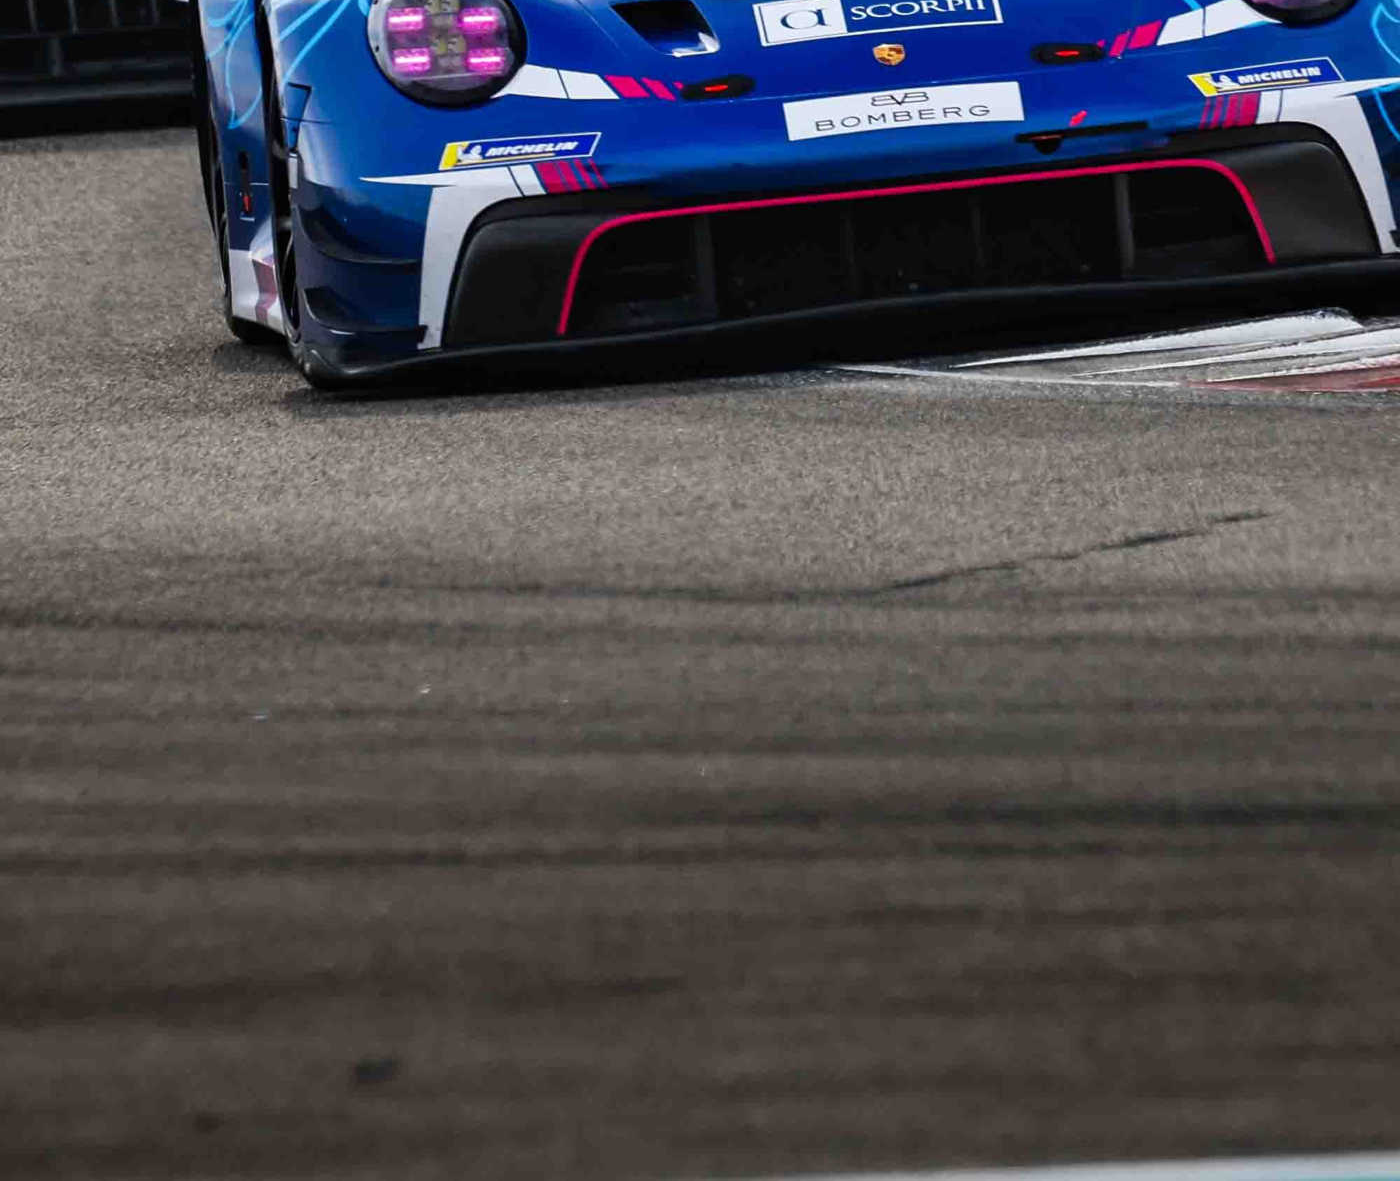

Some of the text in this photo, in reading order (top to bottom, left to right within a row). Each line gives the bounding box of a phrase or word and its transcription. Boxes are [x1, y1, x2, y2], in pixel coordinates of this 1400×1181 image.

[1236, 65, 1322, 85] MICHELIN
[815, 104, 992, 132] BOMBERG
[484, 141, 580, 158] MICHELIN
